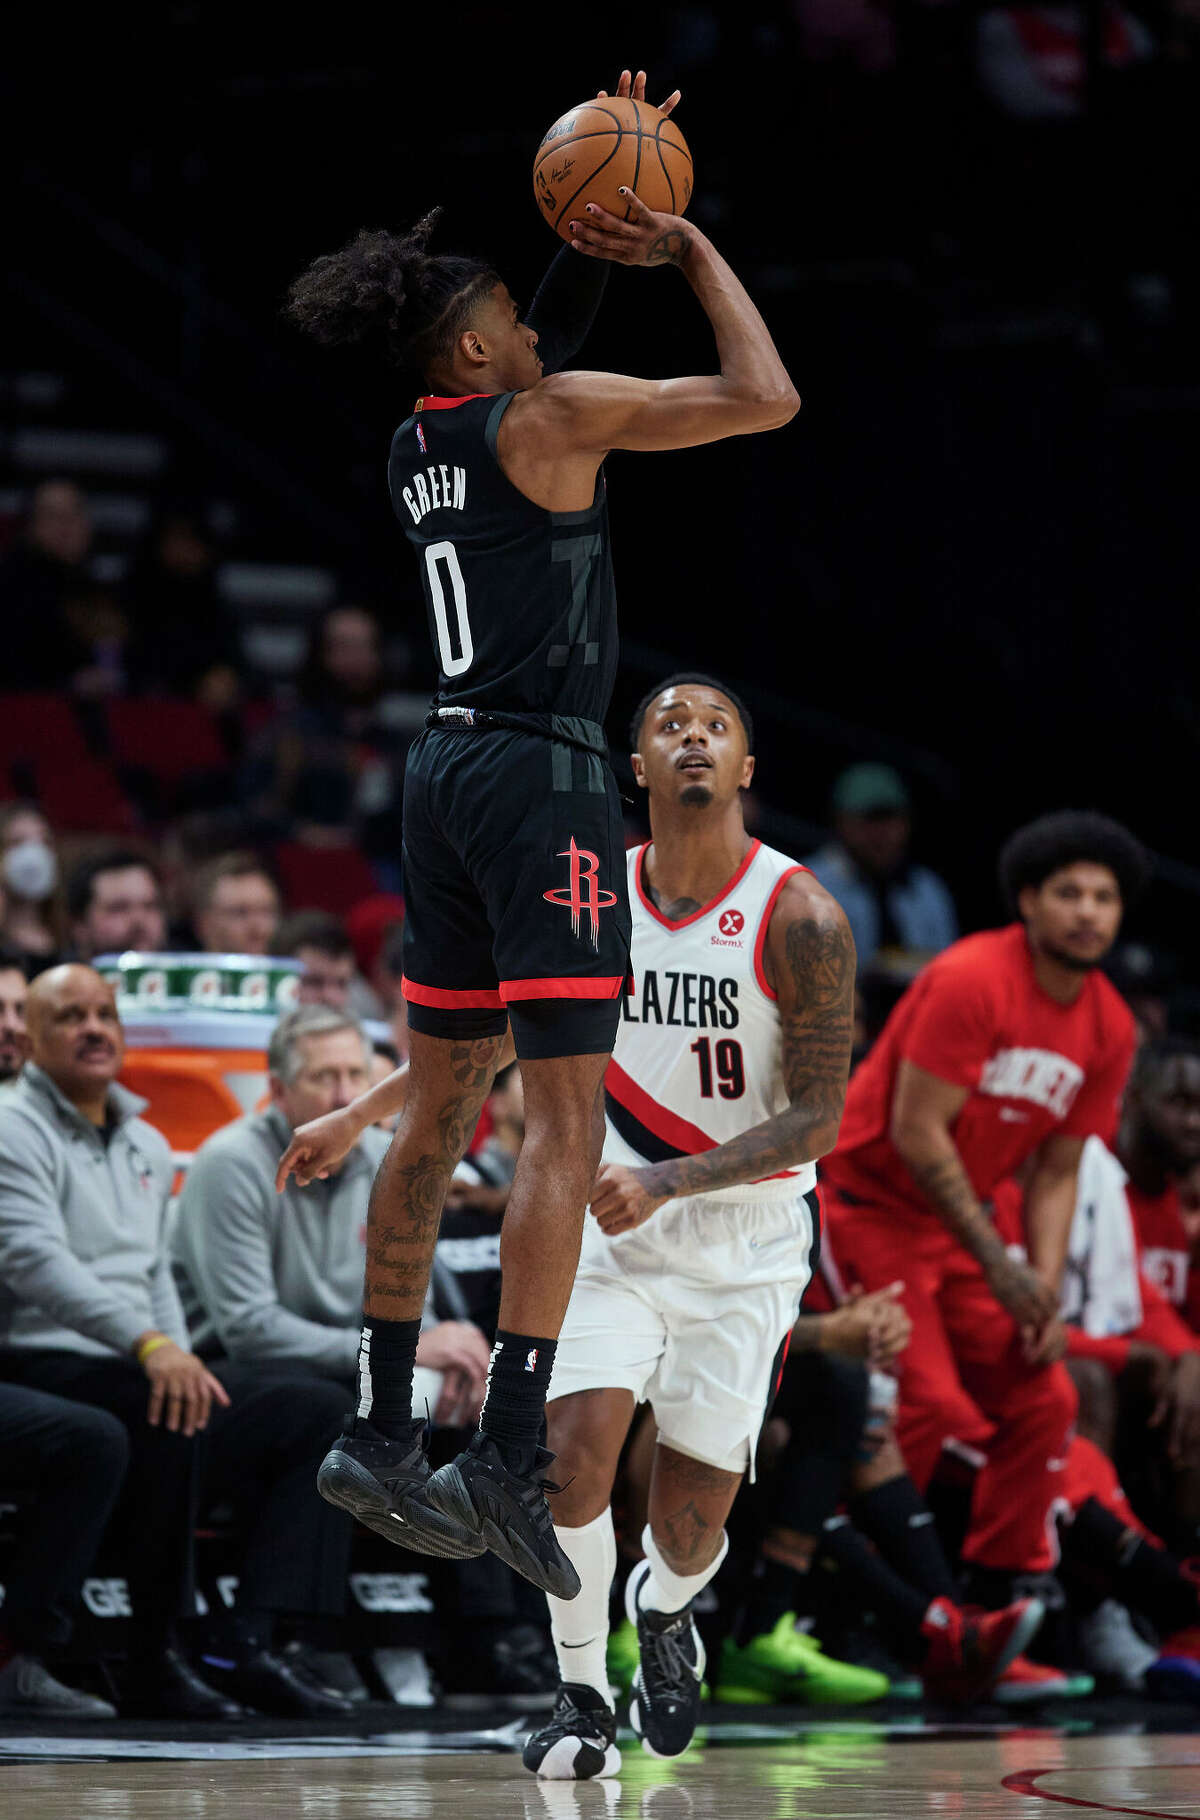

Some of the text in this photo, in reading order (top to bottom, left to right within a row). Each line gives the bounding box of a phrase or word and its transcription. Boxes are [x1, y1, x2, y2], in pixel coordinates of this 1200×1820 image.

[403, 464, 466, 525] GREEN
[425, 541, 473, 677] 0
[711, 936, 744, 949] StormX
[623, 970, 739, 1030] LAZERS
[690, 1036, 746, 1101] 19
